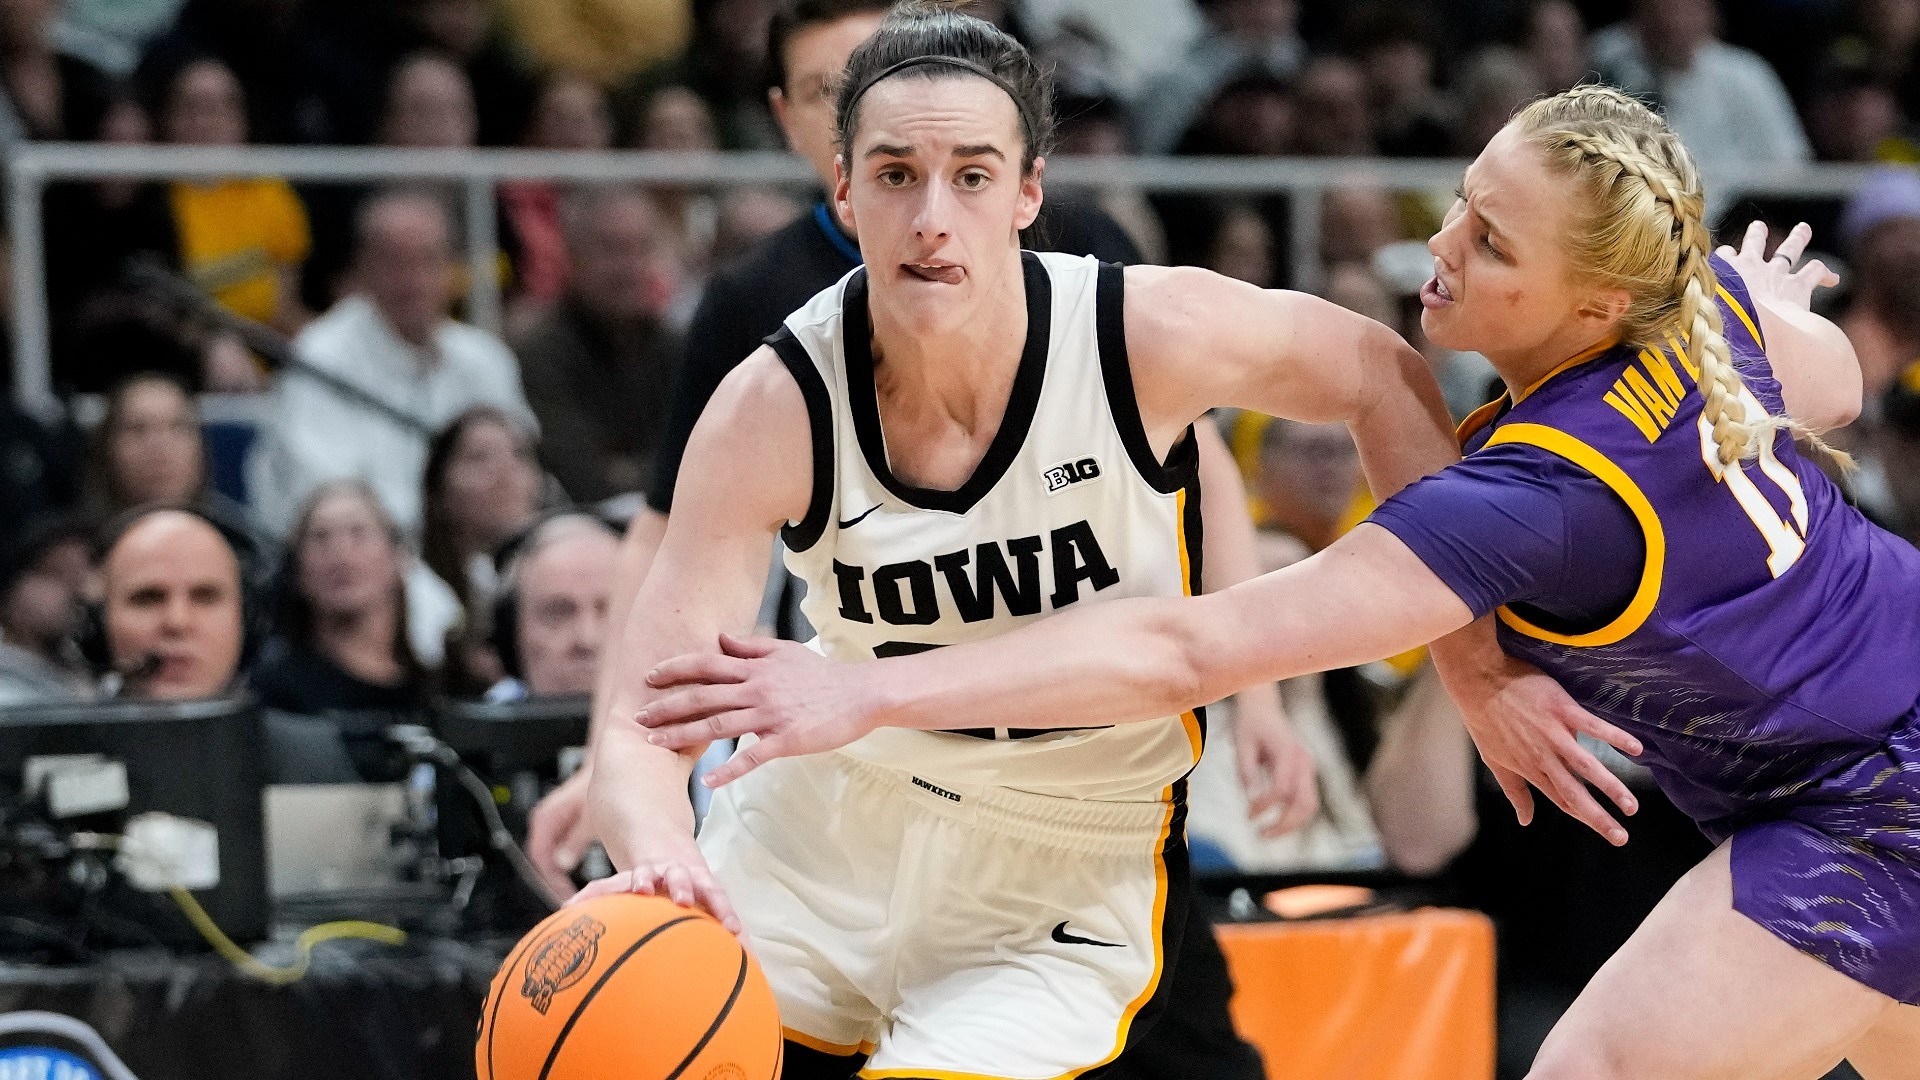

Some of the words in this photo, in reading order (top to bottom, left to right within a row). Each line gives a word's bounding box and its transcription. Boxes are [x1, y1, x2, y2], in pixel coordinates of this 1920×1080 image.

[1602, 341, 1687, 444] VAN
[1697, 381, 1810, 580] 11
[833, 519, 1120, 625] IOWA
[911, 776, 962, 802] HAWKEYES
